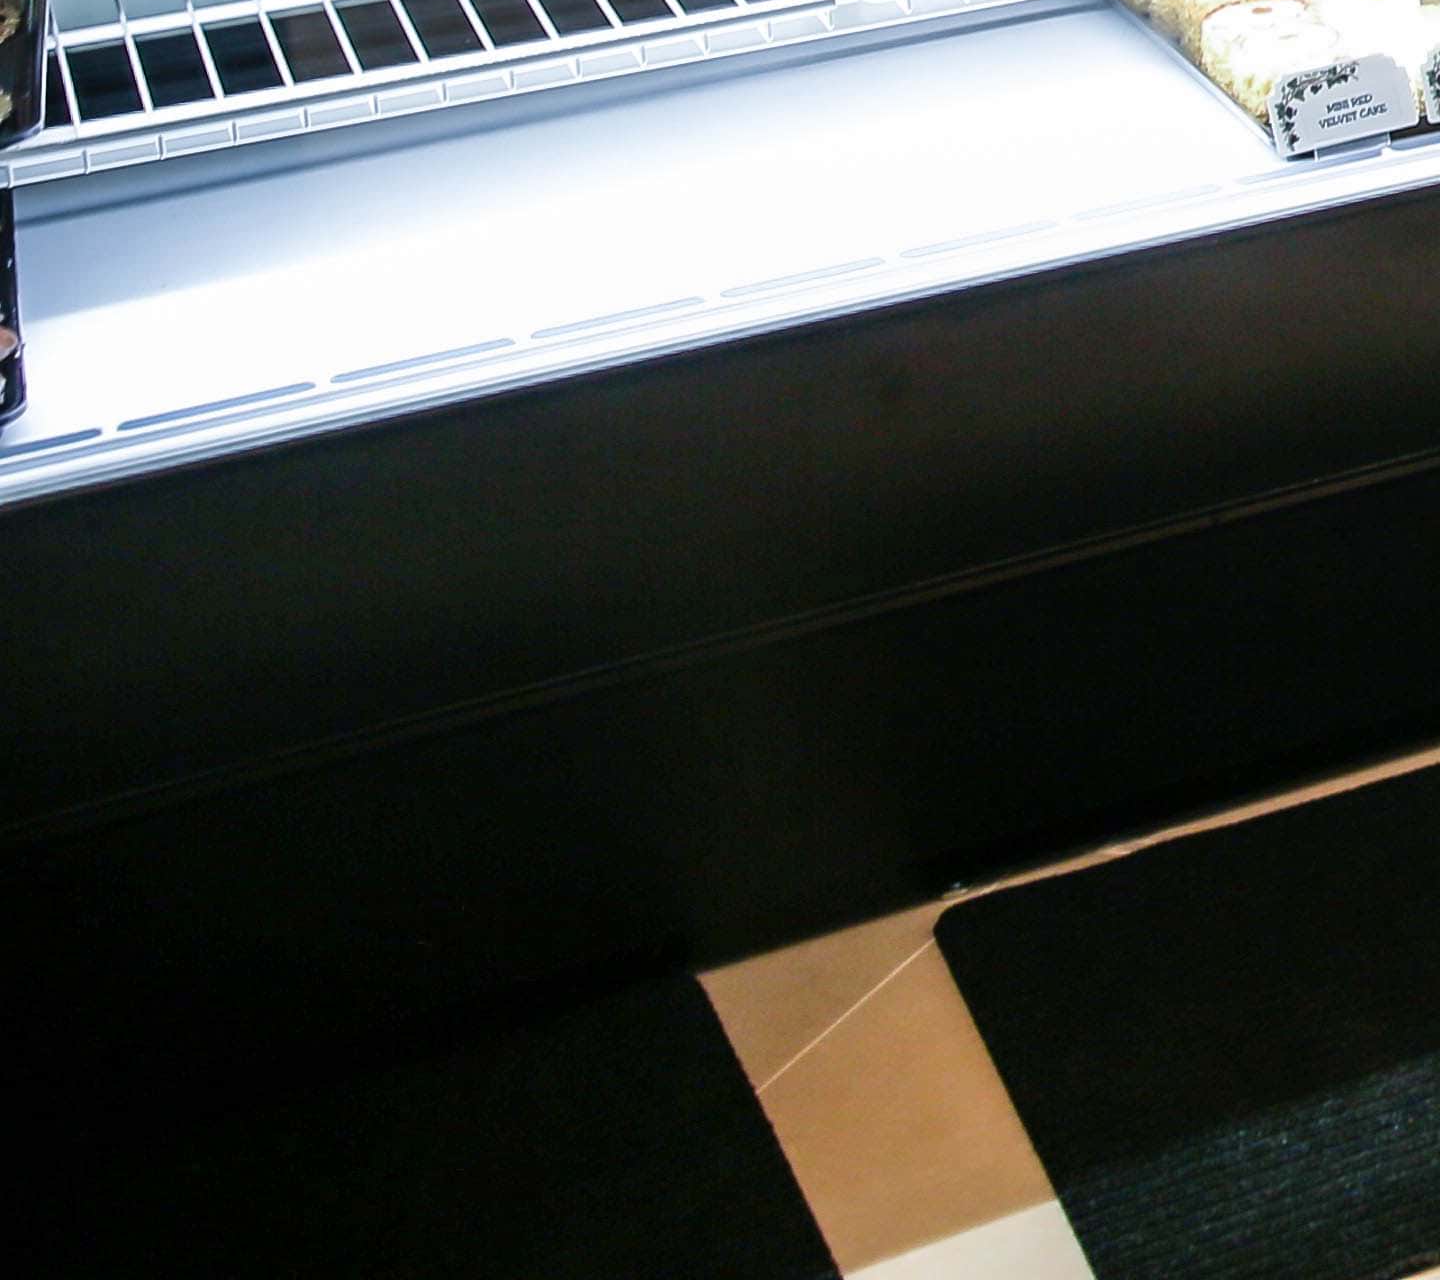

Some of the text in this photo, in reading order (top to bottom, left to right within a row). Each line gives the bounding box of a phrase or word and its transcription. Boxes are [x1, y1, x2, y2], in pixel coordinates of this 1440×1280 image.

[1350, 93, 1374, 109] RED
[1318, 103, 1388, 130] VELVET CAKE
